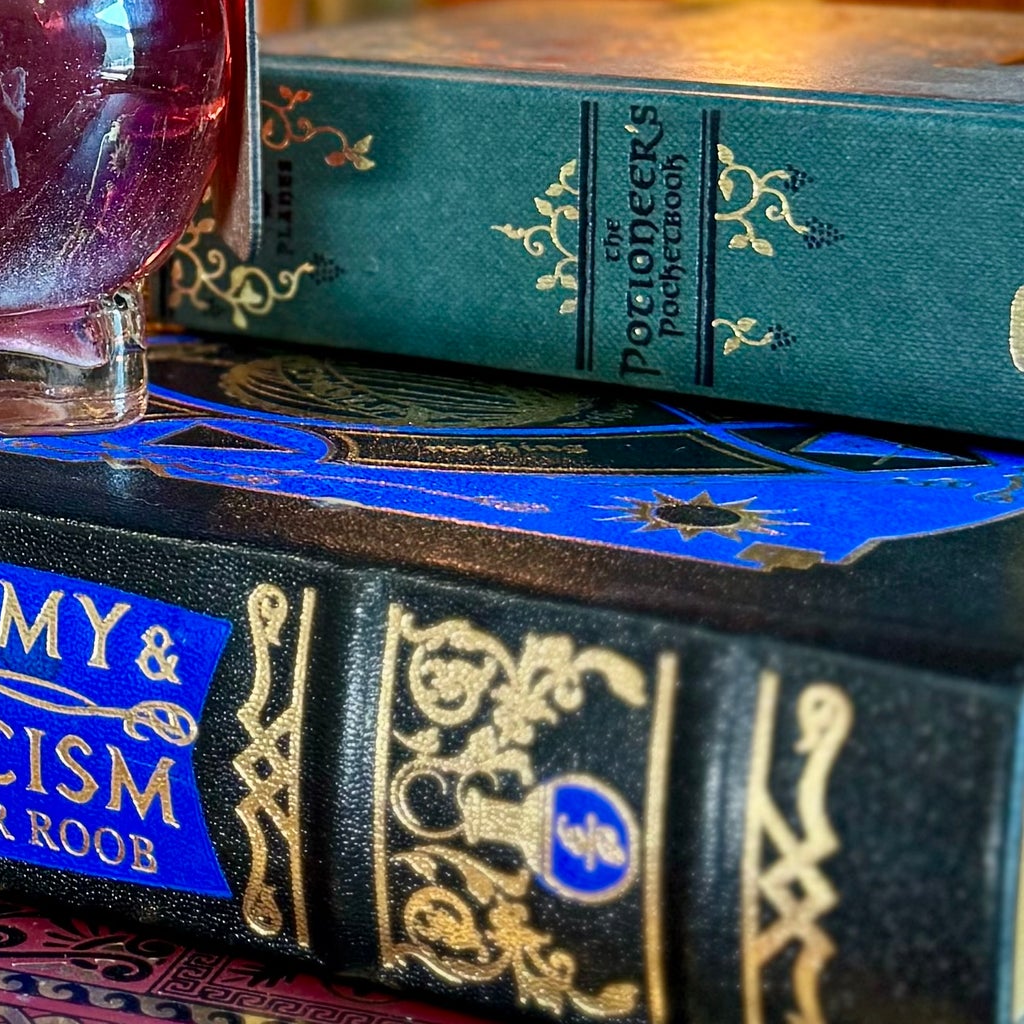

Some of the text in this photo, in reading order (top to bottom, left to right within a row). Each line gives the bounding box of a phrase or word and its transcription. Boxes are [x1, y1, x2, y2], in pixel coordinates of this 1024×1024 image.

[601, 218, 625, 262] the
[139, 624, 182, 685] &
[30, 810, 158, 874] ROOB
